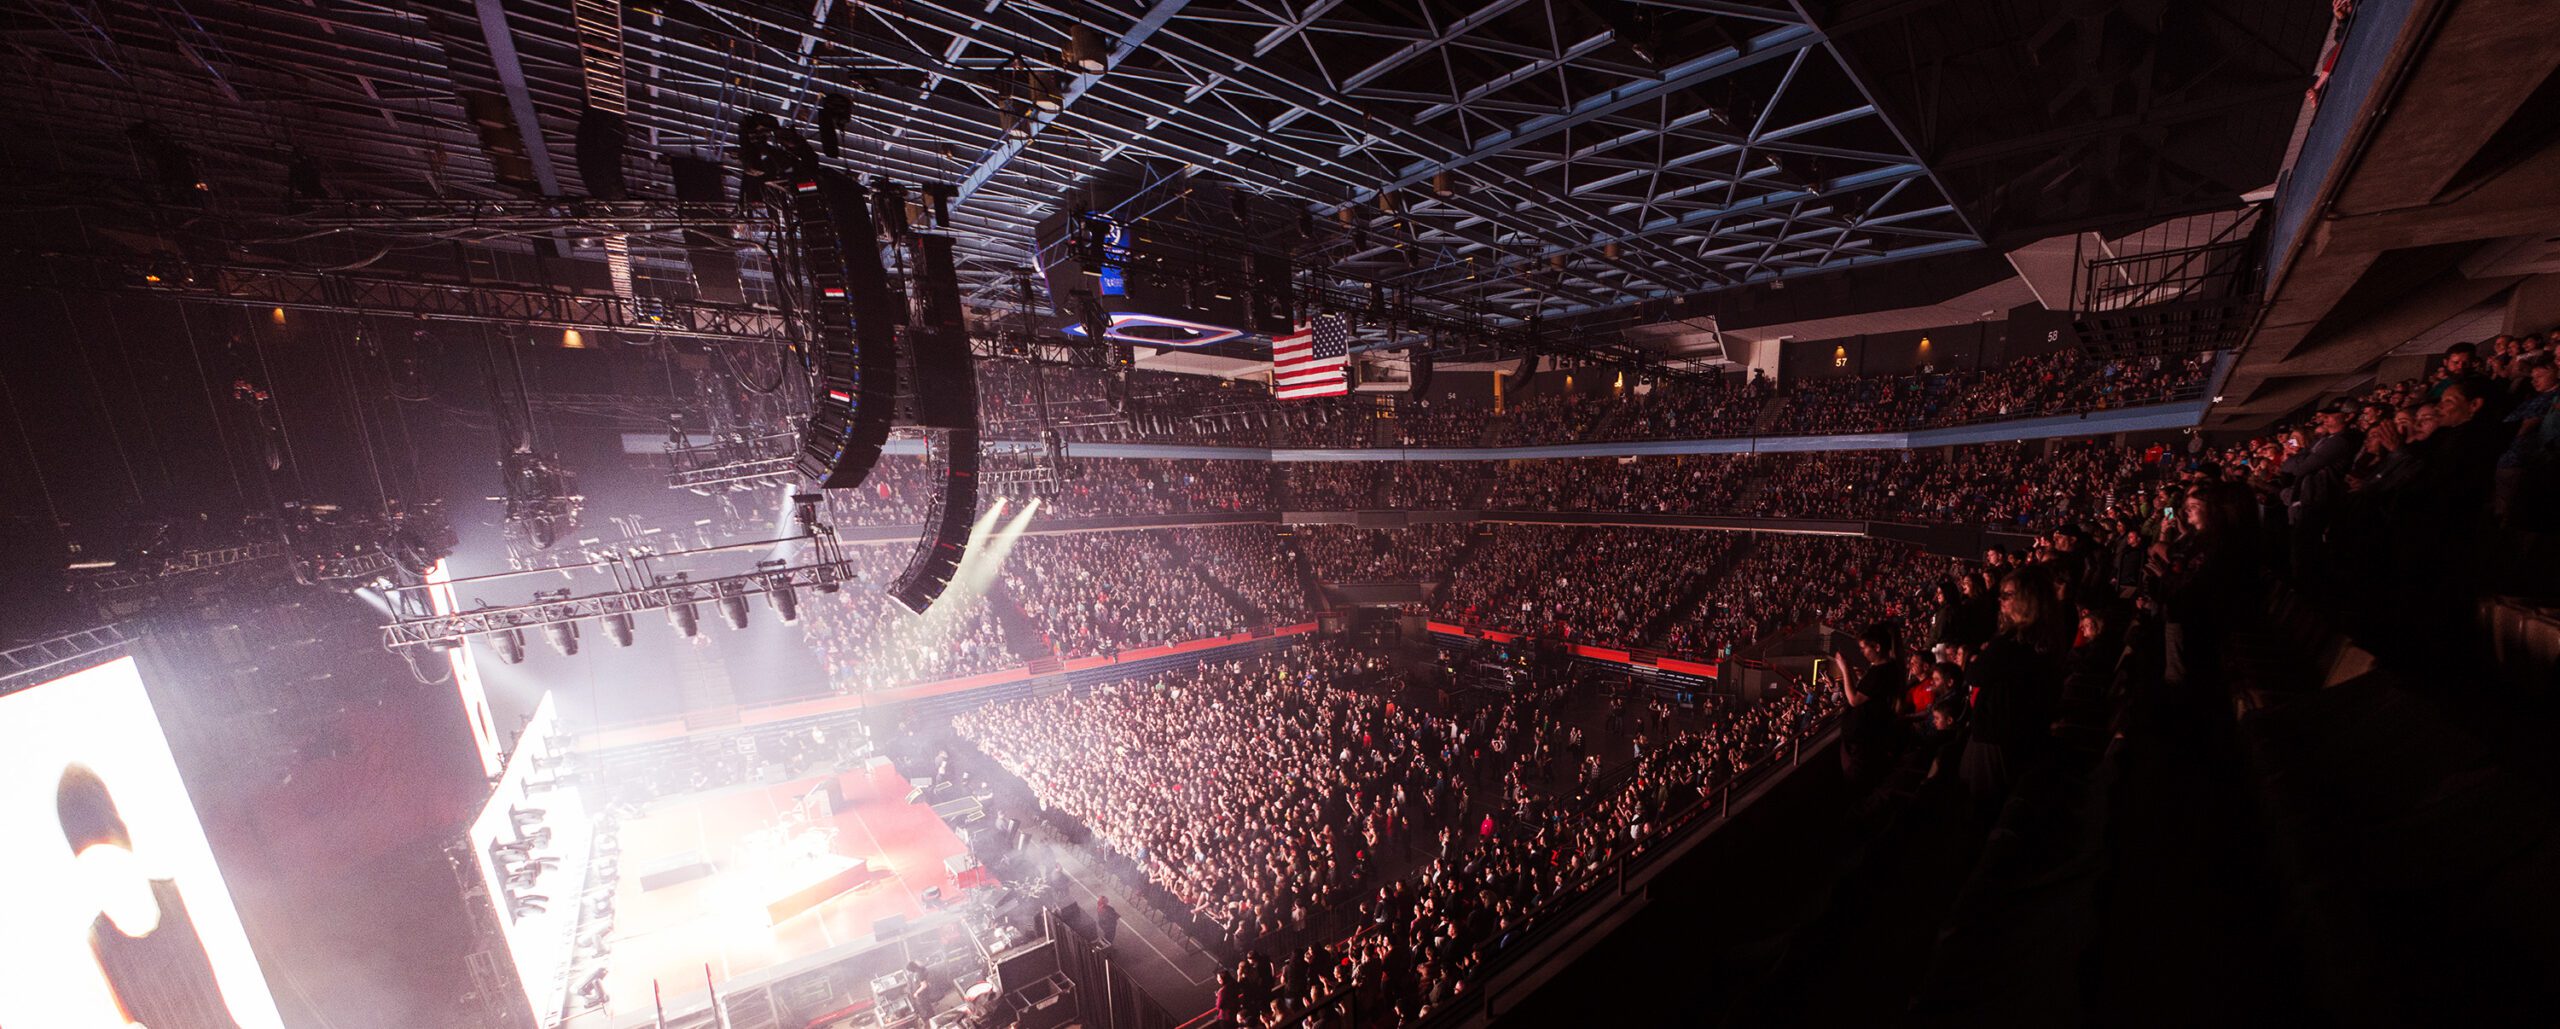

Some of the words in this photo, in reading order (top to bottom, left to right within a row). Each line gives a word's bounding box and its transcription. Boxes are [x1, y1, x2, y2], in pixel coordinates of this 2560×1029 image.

[2047, 330, 2058, 342] 58
[1835, 357, 1847, 367] 57
[1447, 392, 1456, 400] 54
